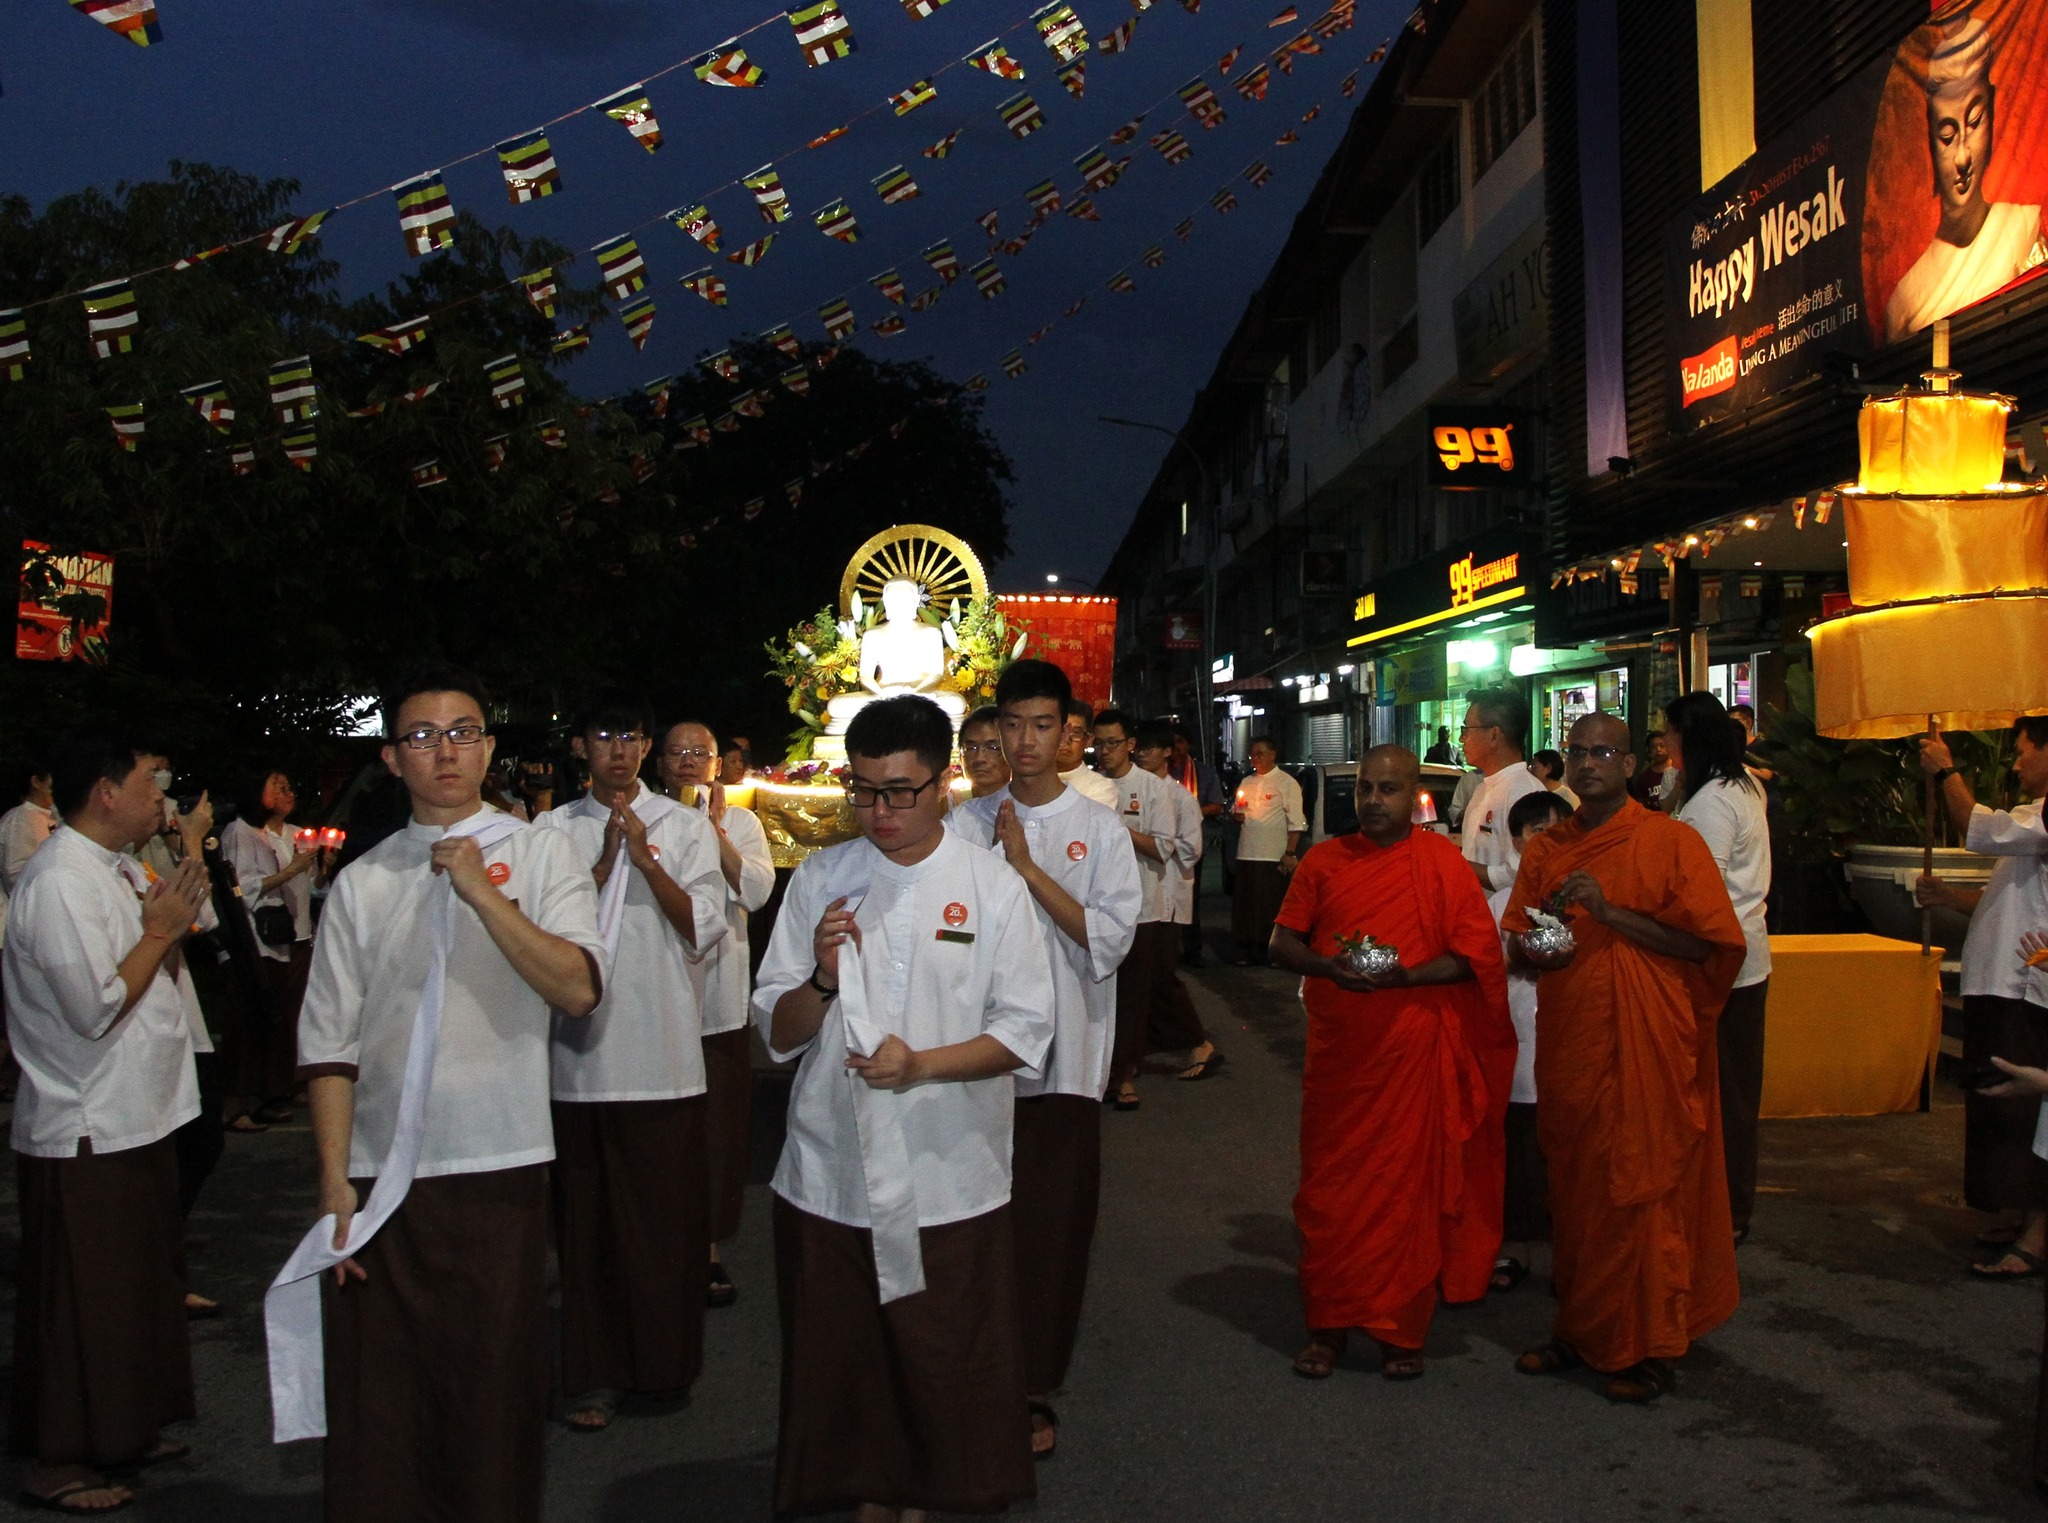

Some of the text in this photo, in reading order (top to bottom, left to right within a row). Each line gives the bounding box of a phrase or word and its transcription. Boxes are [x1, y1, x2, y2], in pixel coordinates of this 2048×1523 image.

[1689, 235, 1756, 319] Happy
[1760, 165, 1847, 272] Wesak
[1487, 270, 1520, 345] AH
[1767, 343, 1778, 362] A
[1433, 425, 1514, 471] 99
[1449, 555, 1473, 608] 99
[1472, 553, 1519, 592] SPEEDMART
